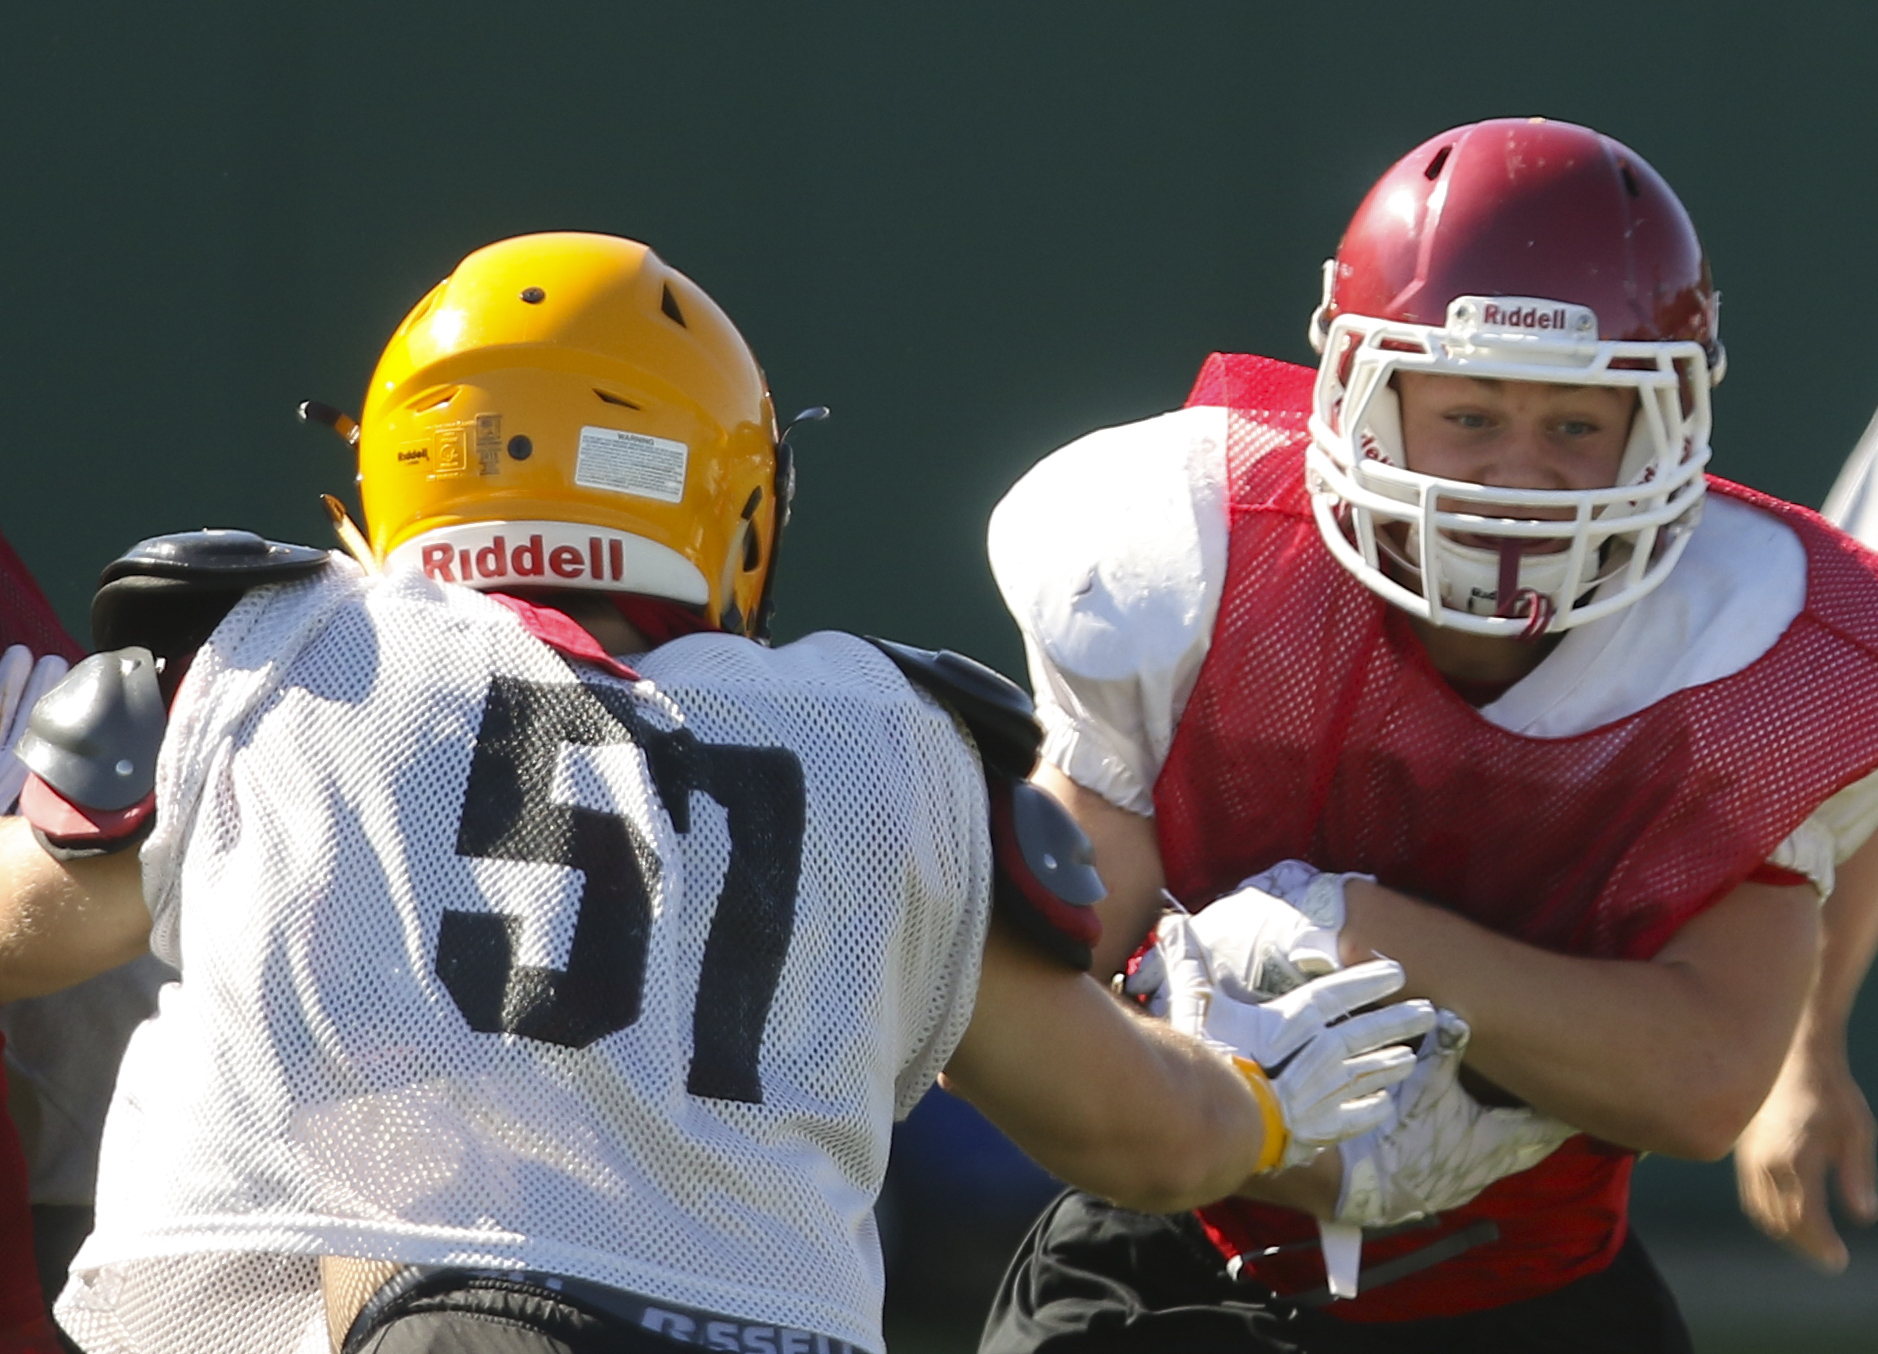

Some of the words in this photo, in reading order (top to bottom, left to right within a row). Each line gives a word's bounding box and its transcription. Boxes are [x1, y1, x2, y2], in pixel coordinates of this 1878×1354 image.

[1484, 303, 1566, 330] Riddell
[618, 432, 655, 446] WARNING
[398, 447, 427, 462] Riddell
[422, 535, 623, 582] Riddell
[435, 674, 807, 1104] 57
